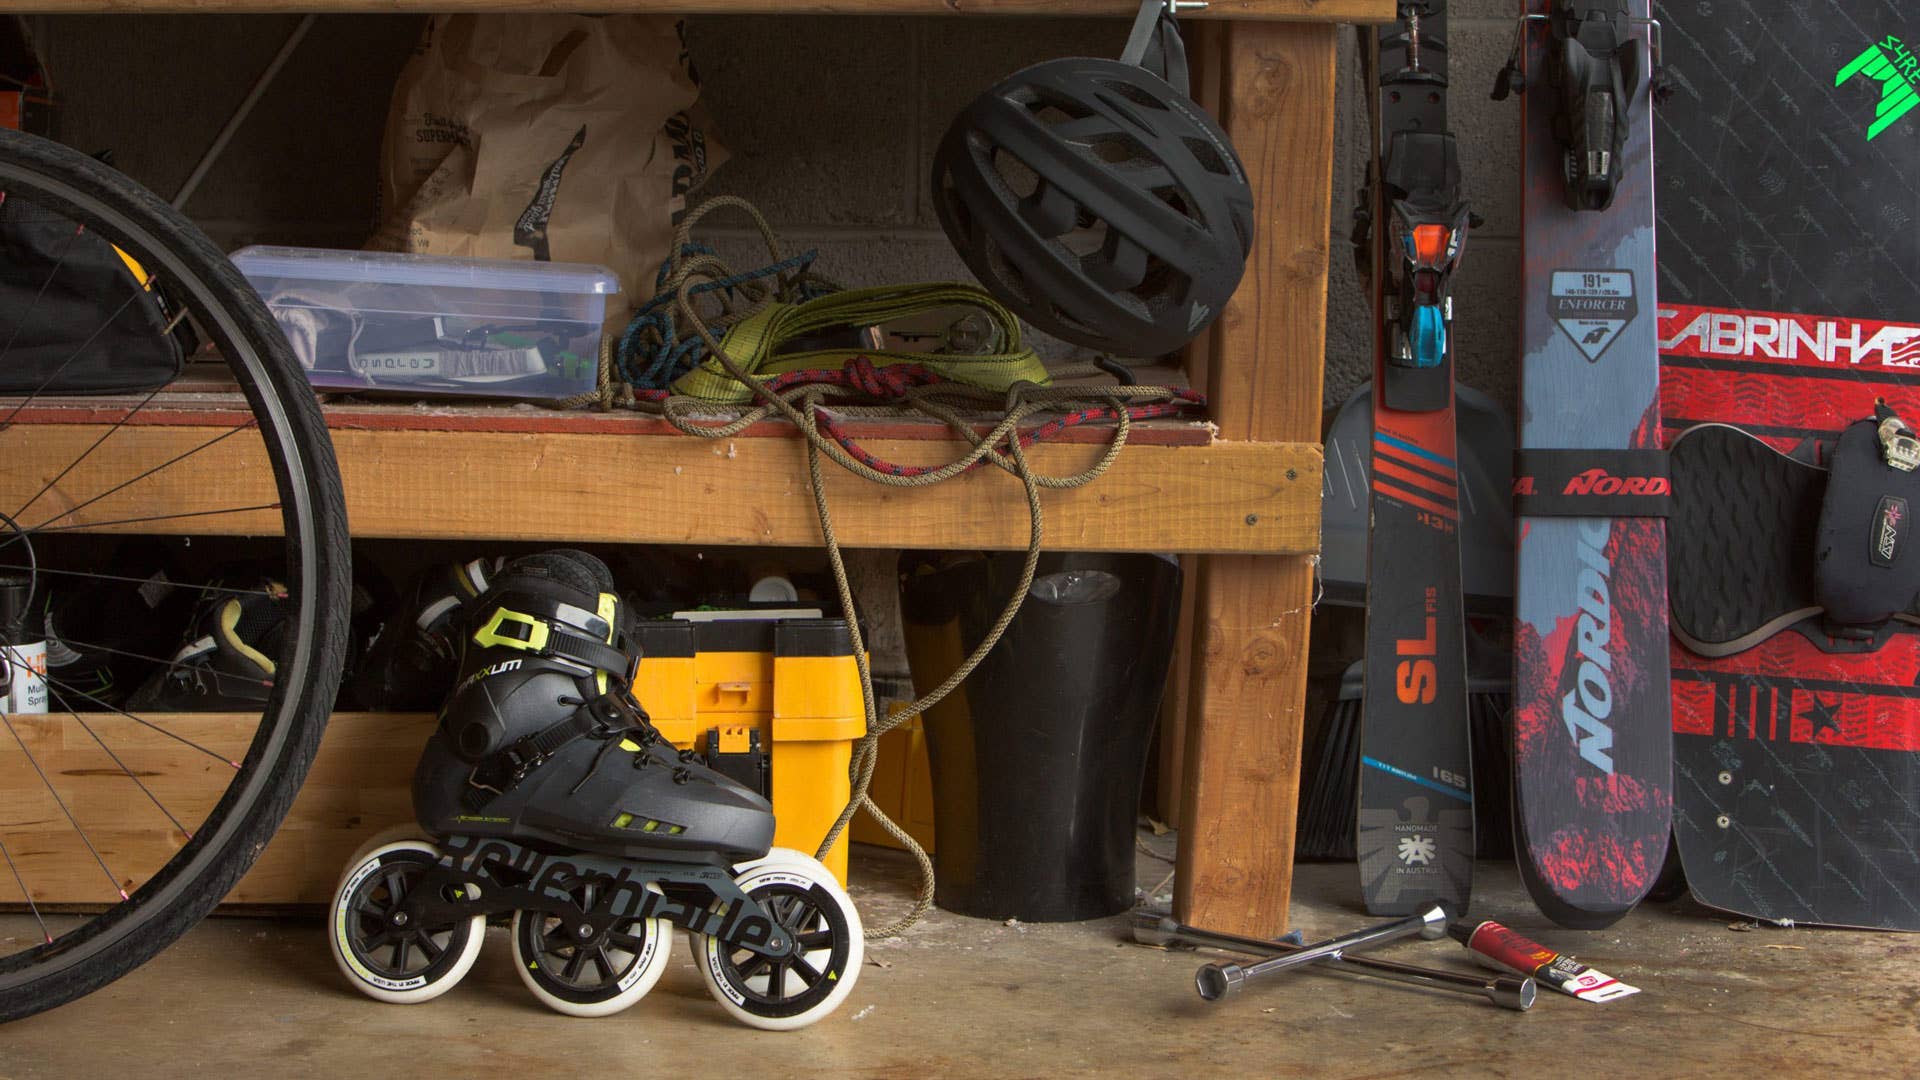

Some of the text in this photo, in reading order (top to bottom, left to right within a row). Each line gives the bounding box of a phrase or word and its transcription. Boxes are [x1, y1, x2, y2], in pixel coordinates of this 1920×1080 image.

[1582, 274, 1601, 288] 191
[1559, 298, 1626, 310] ENFORCER
[1657, 309, 1920, 367] CABRINHA
[1395, 586, 1437, 705] SL FIS
[1432, 766, 1467, 789] 165
[1395, 824, 1438, 833] HANDMADE
[1396, 867, 1438, 875] IN AUSTRIA
